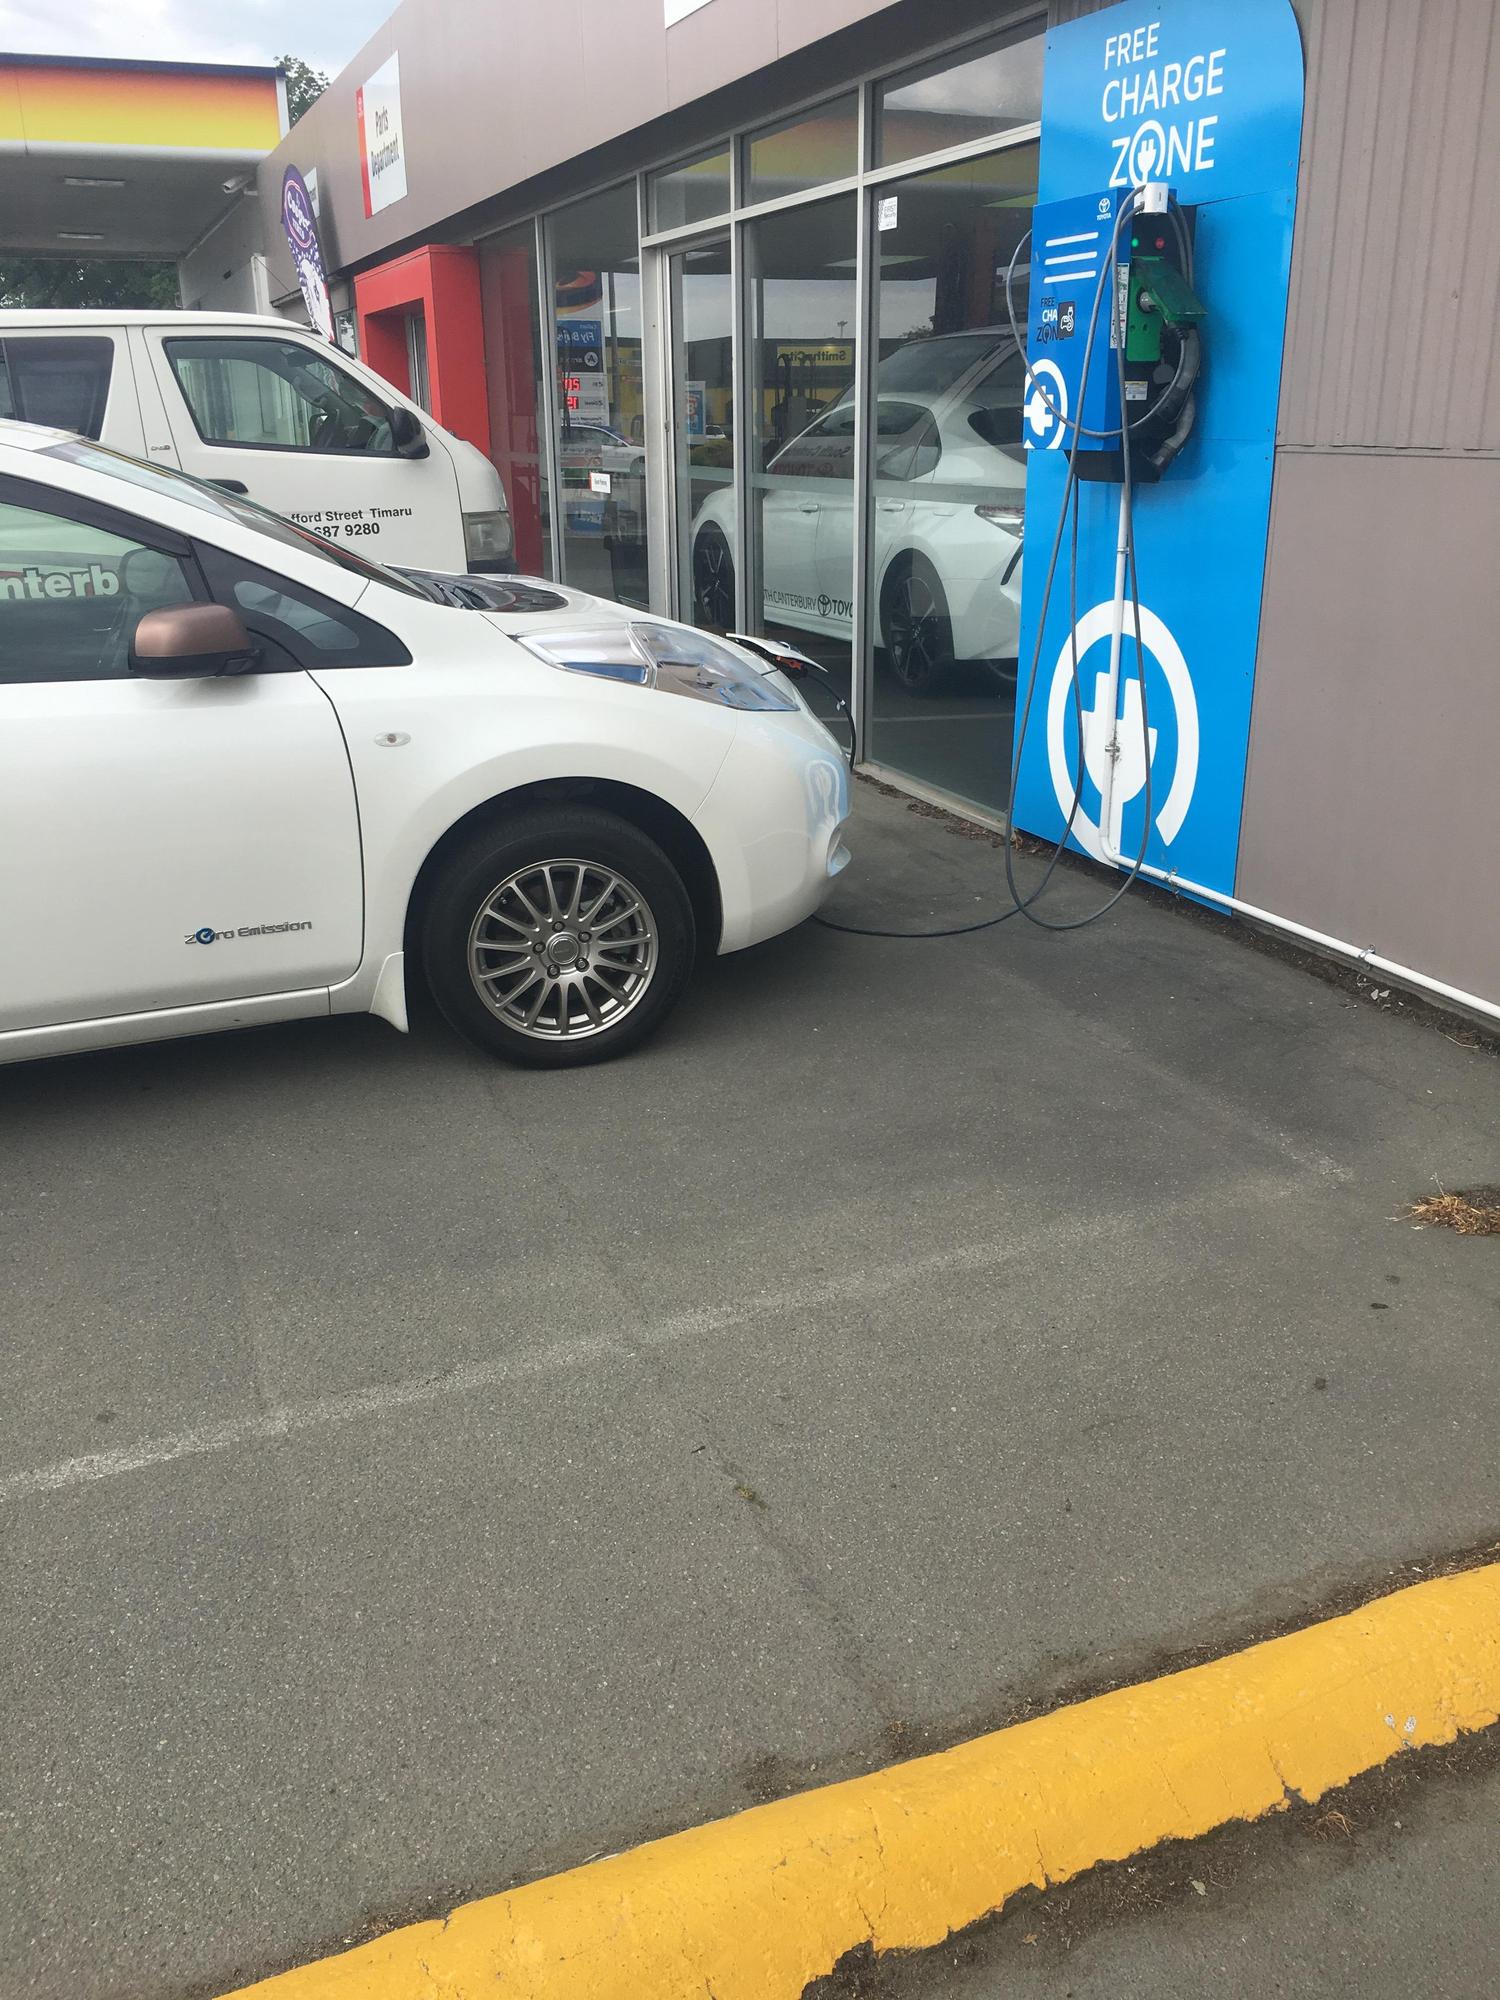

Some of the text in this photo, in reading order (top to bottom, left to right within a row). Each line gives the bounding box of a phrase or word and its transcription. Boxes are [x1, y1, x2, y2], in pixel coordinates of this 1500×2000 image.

[1104, 22, 1160, 71] FREE
[1102, 48, 1227, 123] CHARGE
[375, 105, 389, 138] Parts
[370, 131, 400, 180] Department
[1109, 115, 1219, 188] ZONE
[1040, 297, 1057, 309] FREE
[325, 509, 364, 522] Street
[369, 507, 412, 519] Timaru
[344, 522, 380, 536] 9280
[773, 591, 817, 611] CANTERBURY
[237, 921, 313, 938] Emission
